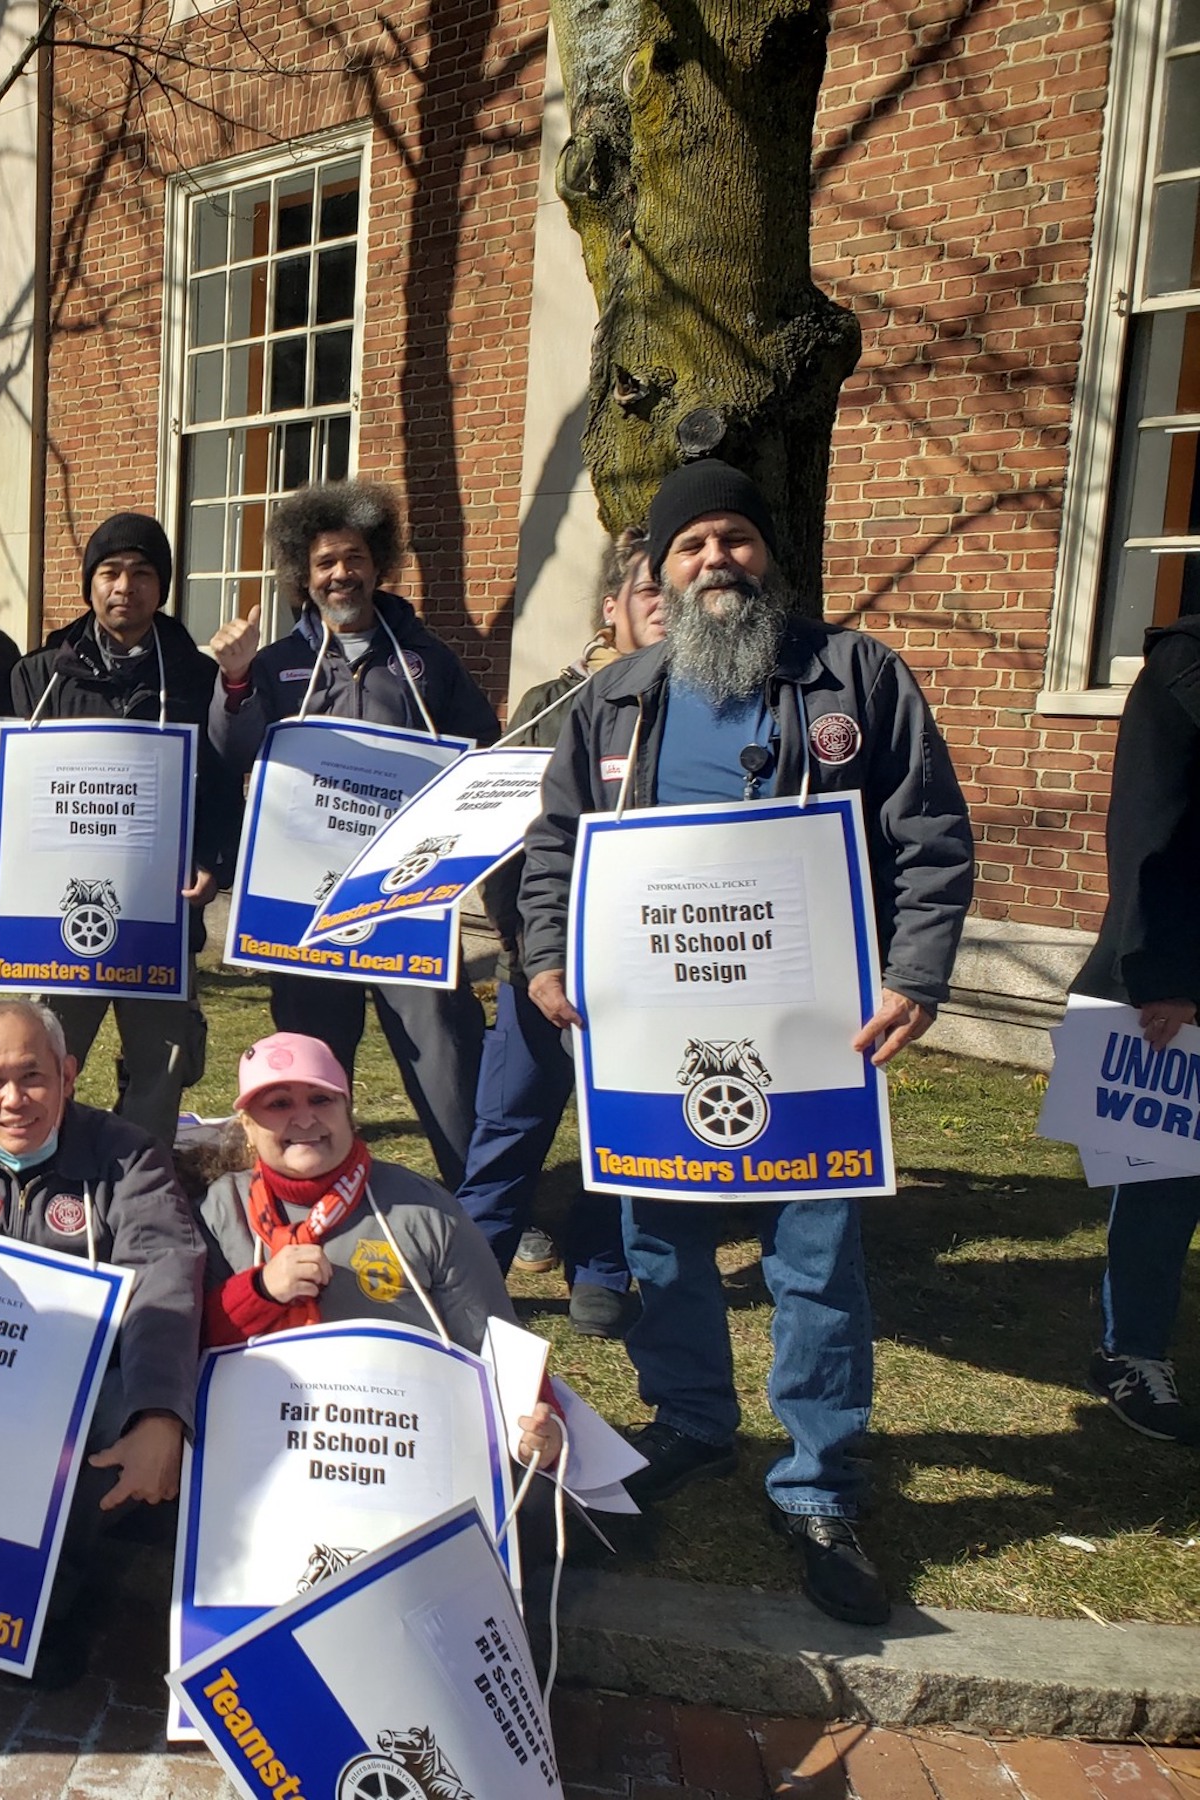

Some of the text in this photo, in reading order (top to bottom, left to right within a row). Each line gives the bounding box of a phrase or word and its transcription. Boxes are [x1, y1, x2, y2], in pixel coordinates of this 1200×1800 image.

[820, 733, 850, 746] RISD
[51, 780, 138, 796] Fair Contract
[312, 773, 404, 803] Fair Contract
[466, 779, 542, 789] Fair Contrac
[471, 789, 521, 799] School
[56, 800, 136, 816] RI School of
[315, 794, 330, 808] RI
[332, 796, 382, 818] School
[454, 801, 502, 811] Design
[70, 821, 117, 836] Design
[327, 815, 377, 836] Design
[647, 880, 758, 891] INFORMATIONAL PICKET
[314, 883, 466, 931] Teamsters Local 251
[641, 901, 774, 925] Fair Contract
[650, 930, 772, 953] RI School of
[239, 934, 443, 975] Teamsters Local 251
[95, 962, 142, 983] Local
[147, 965, 176, 986] 251
[674, 962, 747, 983] Design
[1101, 1031, 1200, 1103] UNION
[1096, 1086, 1200, 1141] WOR
[595, 1147, 874, 1182] Teamsters Local 251
[290, 1382, 406, 1397] INFORMATIONAL PICKET
[280, 1402, 419, 1431] Fair Contract
[287, 1430, 416, 1459] RI School of
[309, 1459, 385, 1485] Design
[484, 1616, 559, 1780] Fair Contract
[474, 1635, 555, 1788] RI School of
[474, 1672, 529, 1766] Design
[203, 1667, 307, 1800] Teamst
[347, 1761, 425, 1800] International Brother
